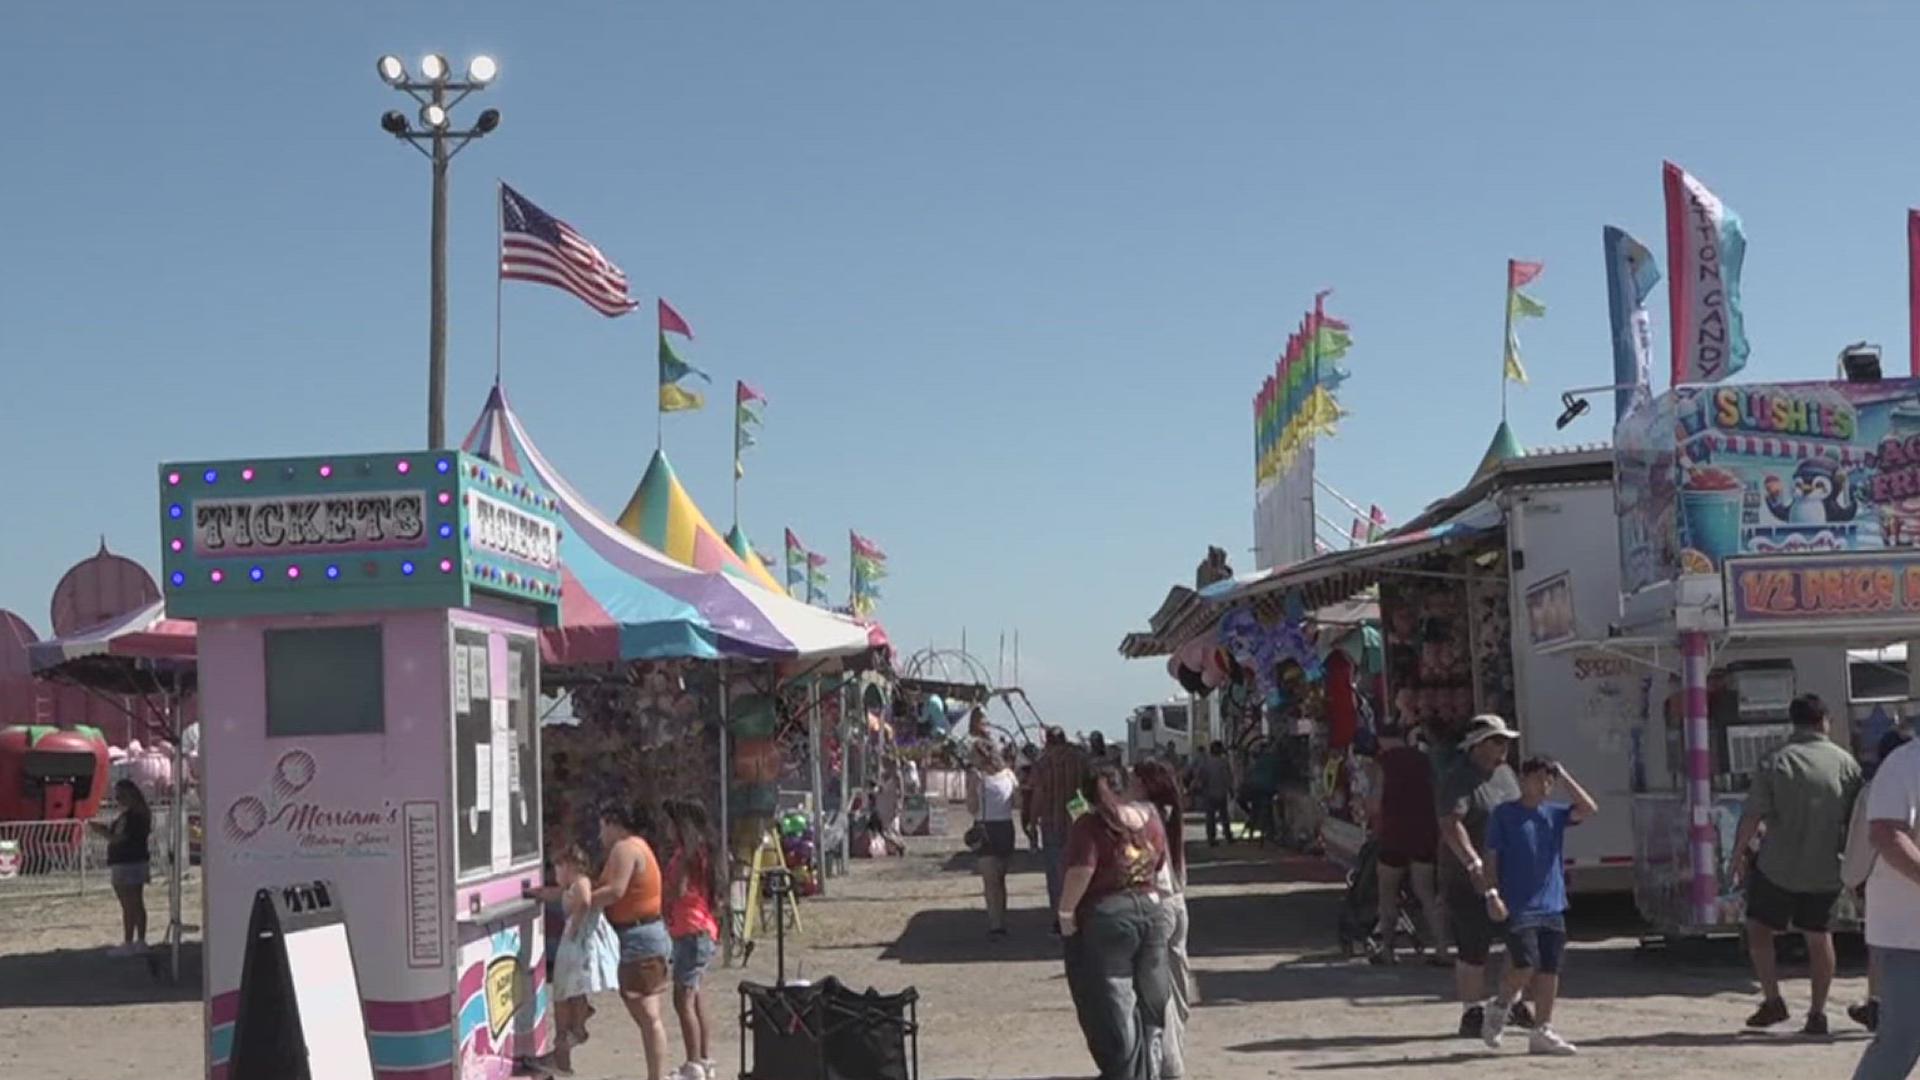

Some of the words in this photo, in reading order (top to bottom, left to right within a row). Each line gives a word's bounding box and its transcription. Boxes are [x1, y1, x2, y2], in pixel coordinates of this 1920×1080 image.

[1698, 289, 1725, 378] CANDY
[198, 496, 424, 549] TICKETS
[477, 497, 552, 564] TICKETS
[1742, 569, 1797, 610] 1/2
[268, 801, 399, 832] Merriam's
